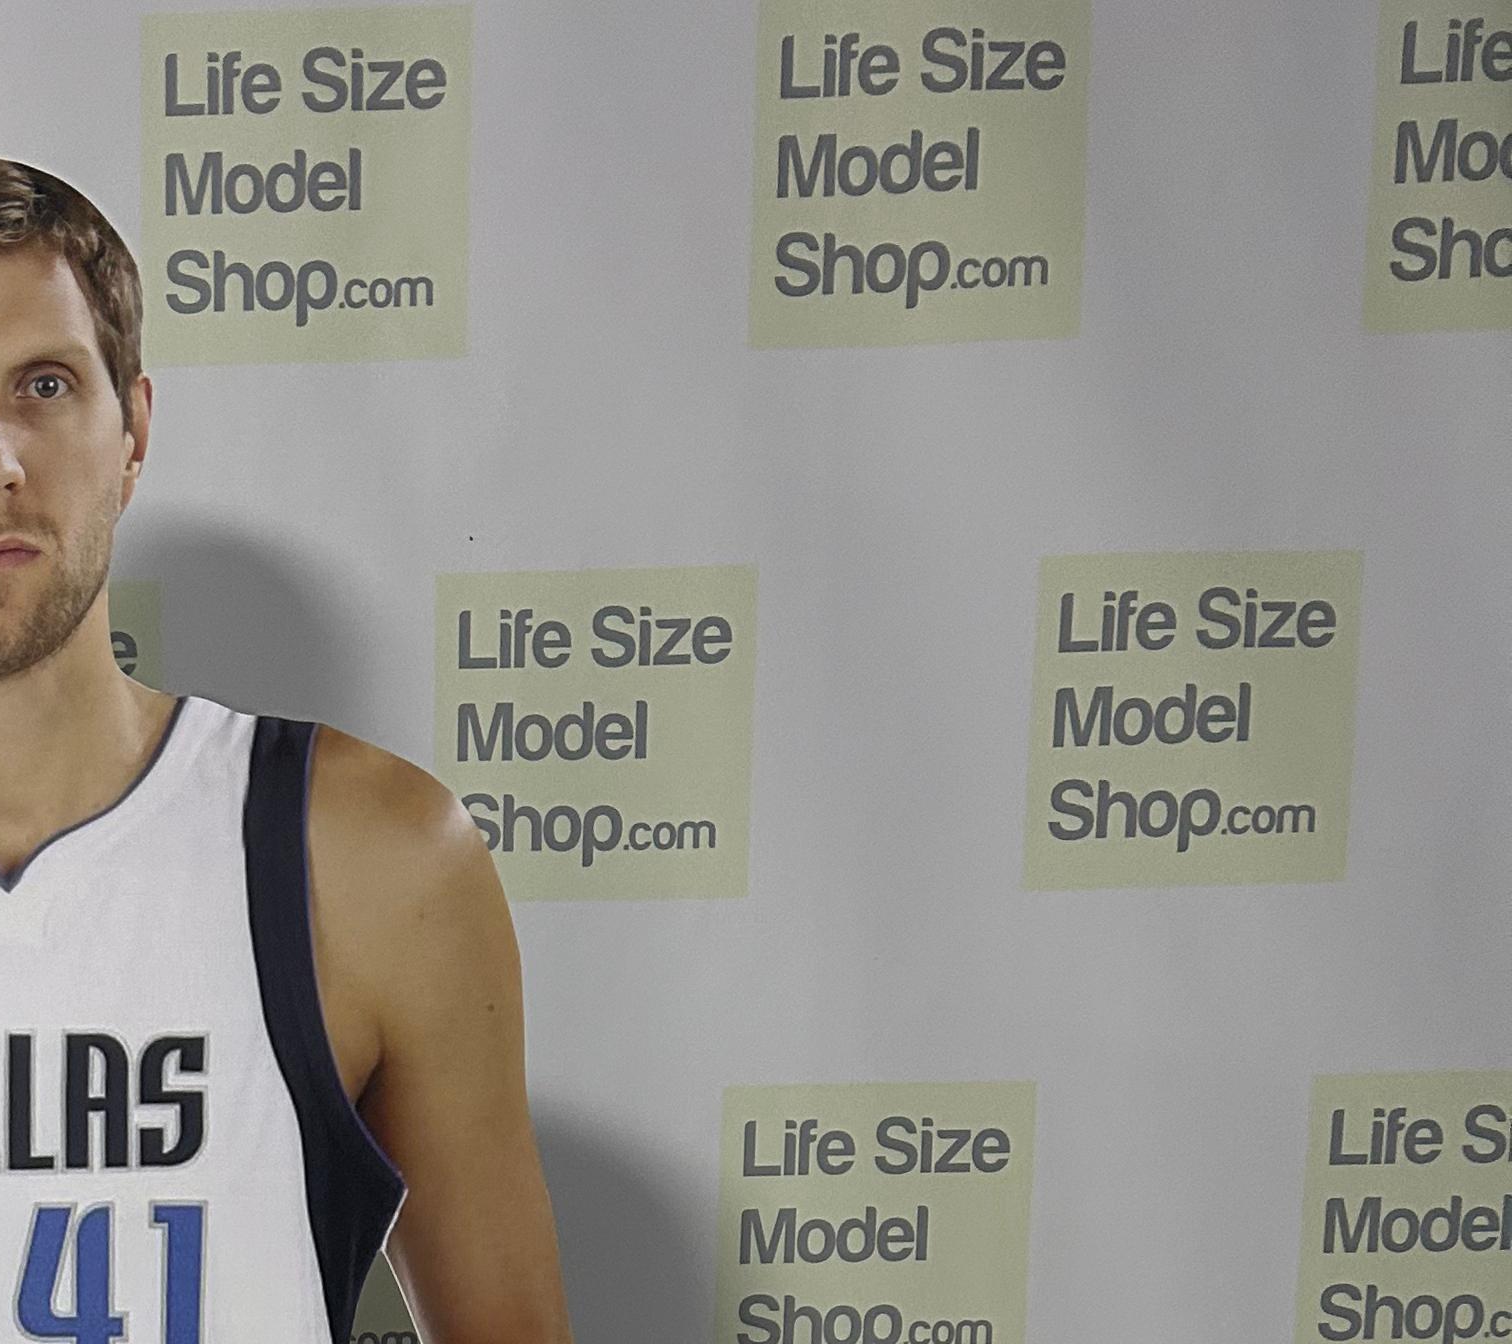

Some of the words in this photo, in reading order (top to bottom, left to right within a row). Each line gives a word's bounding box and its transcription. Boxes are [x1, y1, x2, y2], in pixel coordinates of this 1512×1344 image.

[165, 51, 282, 117] Life
[302, 47, 446, 113] Size
[780, 33, 900, 99] Life
[920, 27, 1066, 93] Size
[1400, 18, 1512, 84] Life
[165, 148, 361, 216] Model
[776, 127, 980, 198] Model
[166, 250, 433, 327] Shop.com
[774, 232, 1048, 309] Shop.com
[458, 609, 572, 669] Life
[591, 606, 732, 668] Size
[1058, 590, 1177, 653] Life
[1196, 587, 1336, 650] Size
[457, 700, 647, 762] Model
[1053, 682, 1251, 748] Model
[461, 793, 717, 868] Shop.com
[1048, 779, 1315, 853] Shop.com
[743, 1119, 855, 1177] Life
[874, 1116, 1010, 1175] Size
[1329, 1107, 1443, 1166] Life
[739, 1205, 928, 1265] Model
[1323, 1194, 1512, 1254] Model
